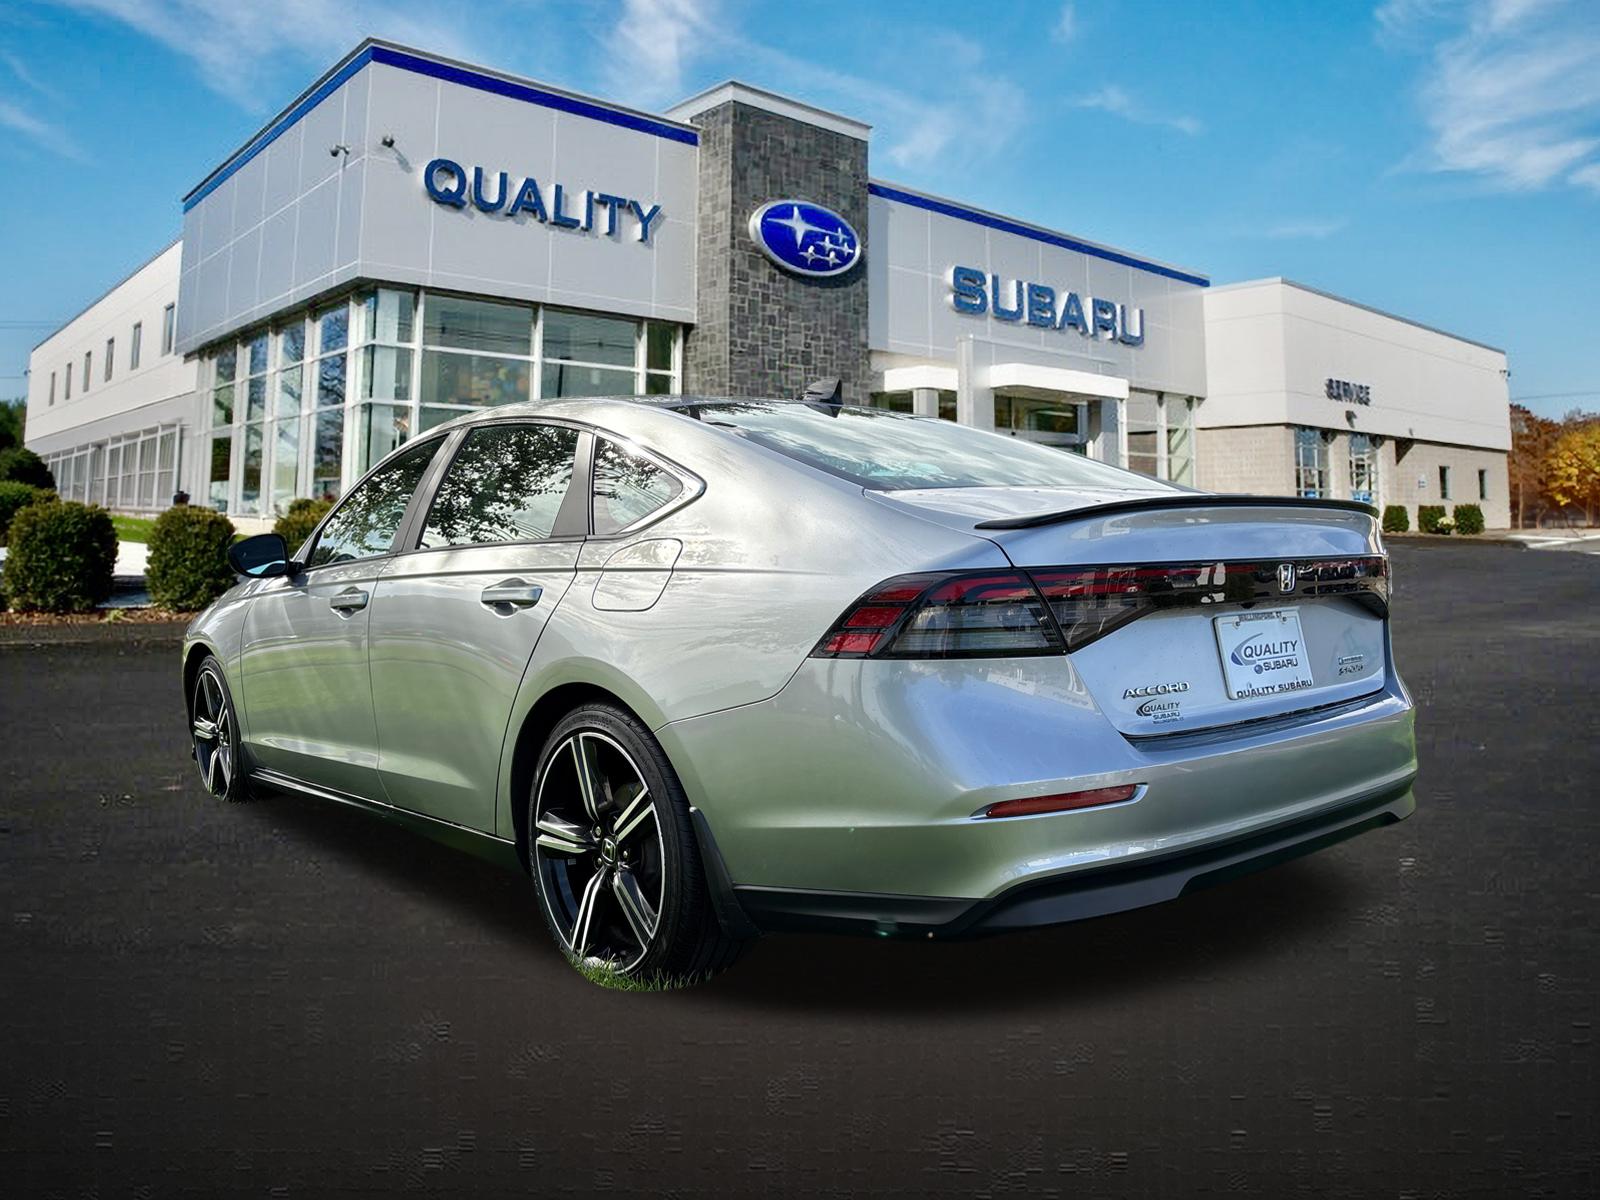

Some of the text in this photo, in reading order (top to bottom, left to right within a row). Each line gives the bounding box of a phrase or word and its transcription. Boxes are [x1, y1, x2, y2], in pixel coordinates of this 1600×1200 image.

[424, 158, 662, 243] QUALITY
[946, 265, 1145, 347] SUBARU
[1325, 378, 1371, 407] SERVICE
[1243, 640, 1298, 658] QUALITY
[1262, 657, 1299, 672] SUBARU
[1122, 681, 1190, 700] ACCORD
[1236, 679, 1313, 698] QUALITY SUBARU
[1143, 701, 1181, 713] QUALITY
[1152, 711, 1181, 720] SUBARU
